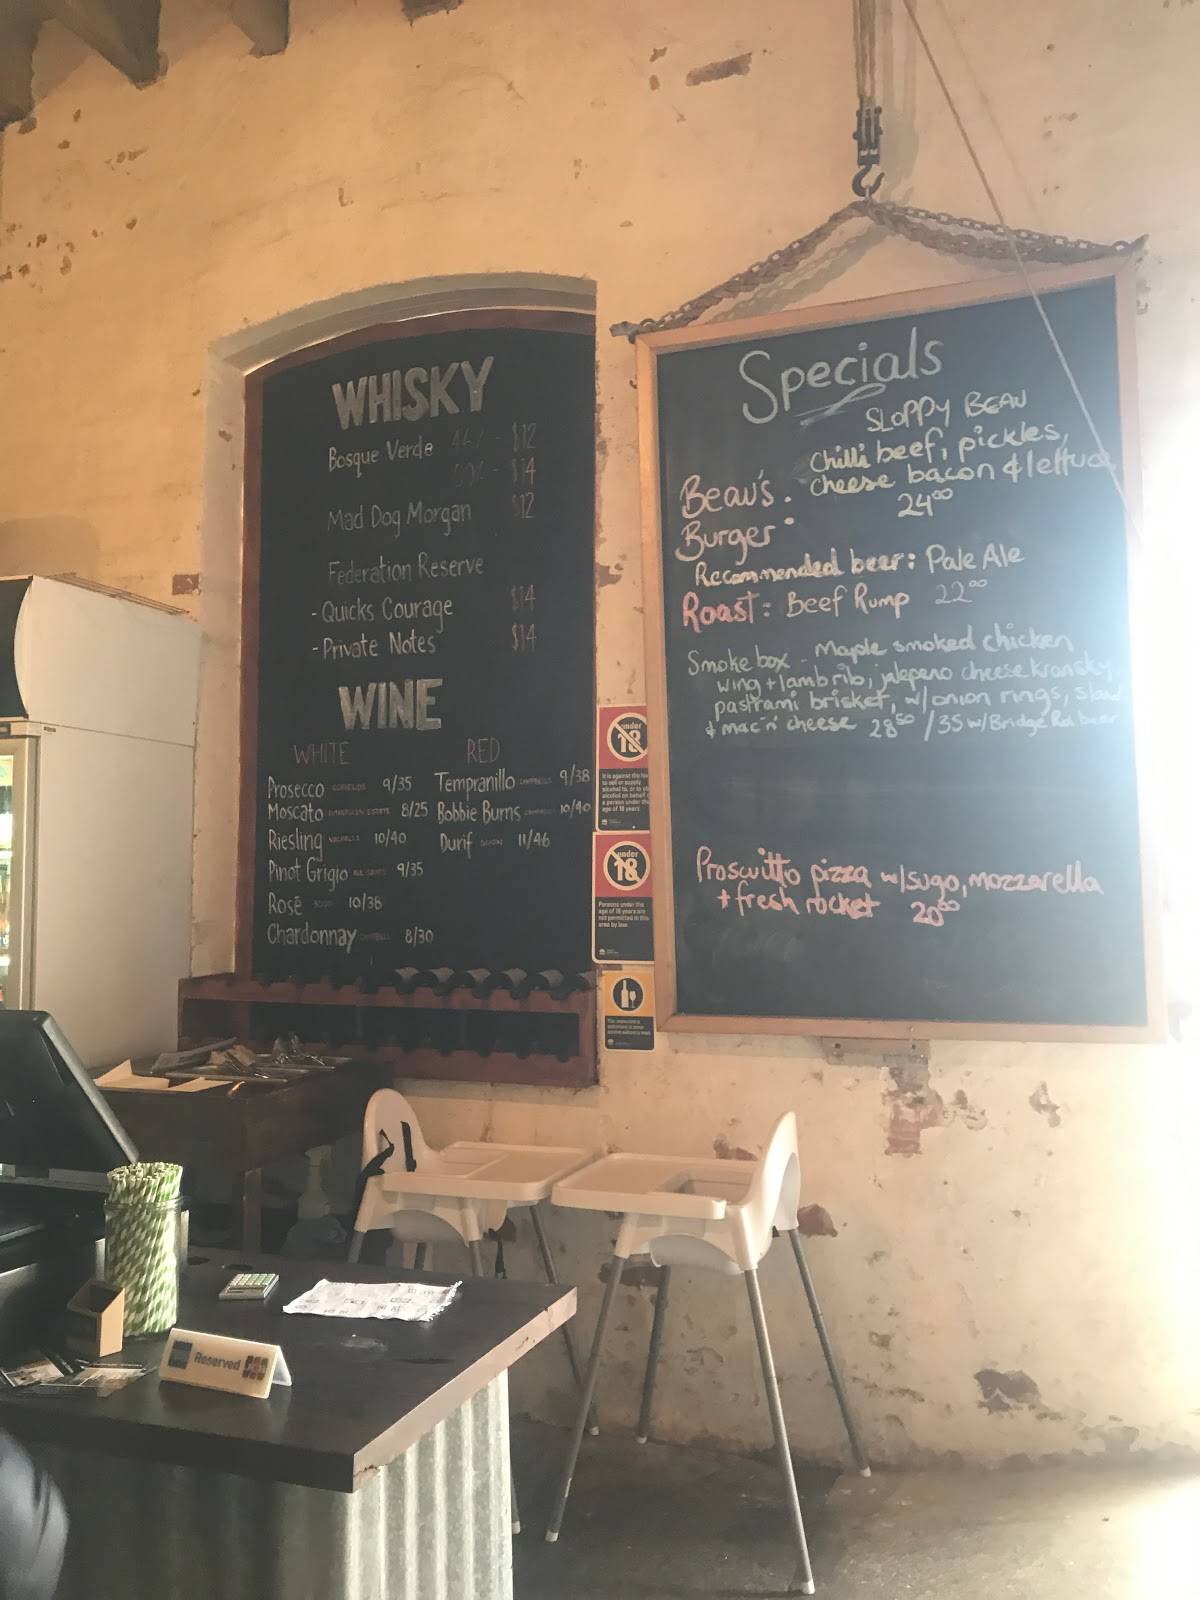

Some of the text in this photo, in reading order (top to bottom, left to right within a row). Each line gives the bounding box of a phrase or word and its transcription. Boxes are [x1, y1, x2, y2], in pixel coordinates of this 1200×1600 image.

[331, 356, 494, 430] WHISKY
[740, 327, 943, 423] Specials
[964, 390, 1026, 417] BEAU
[328, 446, 379, 478] Bosque
[386, 435, 433, 460] Verde
[810, 422, 1068, 473] Chilli beef, pickles,
[907, 464, 995, 483] bacon
[680, 469, 775, 519] Beau's
[327, 506, 363, 531] Mad
[371, 504, 400, 539] Dog
[406, 500, 472, 537] Morgan
[675, 520, 777, 566] Burger
[328, 552, 485, 585] Federation Reserve
[695, 547, 846, 588] Recommended
[925, 543, 976, 574] Pale
[982, 543, 1025, 568] Ale
[382, 596, 454, 634] Courage
[786, 584, 848, 621] Beef
[855, 582, 910, 620] Rump
[389, 629, 437, 656] Notes
[815, 638, 887, 664] Maple
[893, 624, 976, 653] smoked
[983, 622, 1074, 652] chicken
[717, 676, 761, 698] wing
[779, 665, 828, 692] lamb
[961, 661, 1028, 682] cheese
[339, 678, 443, 731] WINE
[715, 689, 800, 721] pastrami
[1000, 687, 1069, 715] rings,
[787, 716, 858, 733] cheese
[293, 738, 501, 766] WHITE RED
[267, 776, 325, 800] Prosecco
[382, 774, 413, 797] 9/35
[434, 768, 516, 802] Tempranillo
[559, 764, 591, 787] 9/38
[268, 802, 324, 822] Moscato
[401, 800, 428, 819] 8/25
[437, 799, 592, 825] Bobbie Burns 10/40
[268, 828, 407, 862] Riesling 10/40
[440, 832, 473, 859] Durif
[518, 829, 551, 850] 11/46
[268, 856, 424, 892] Pinot Grigio 9/35
[614, 858, 638, 881] 18
[811, 858, 872, 896] pizza
[969, 859, 1104, 896] mozzarella
[348, 892, 383, 912] 10/38
[735, 880, 800, 917] fresh
[807, 892, 881, 920] rocket
[266, 921, 433, 954] Chardonnay 8/30
[194, 1352, 241, 1371] Reserved
